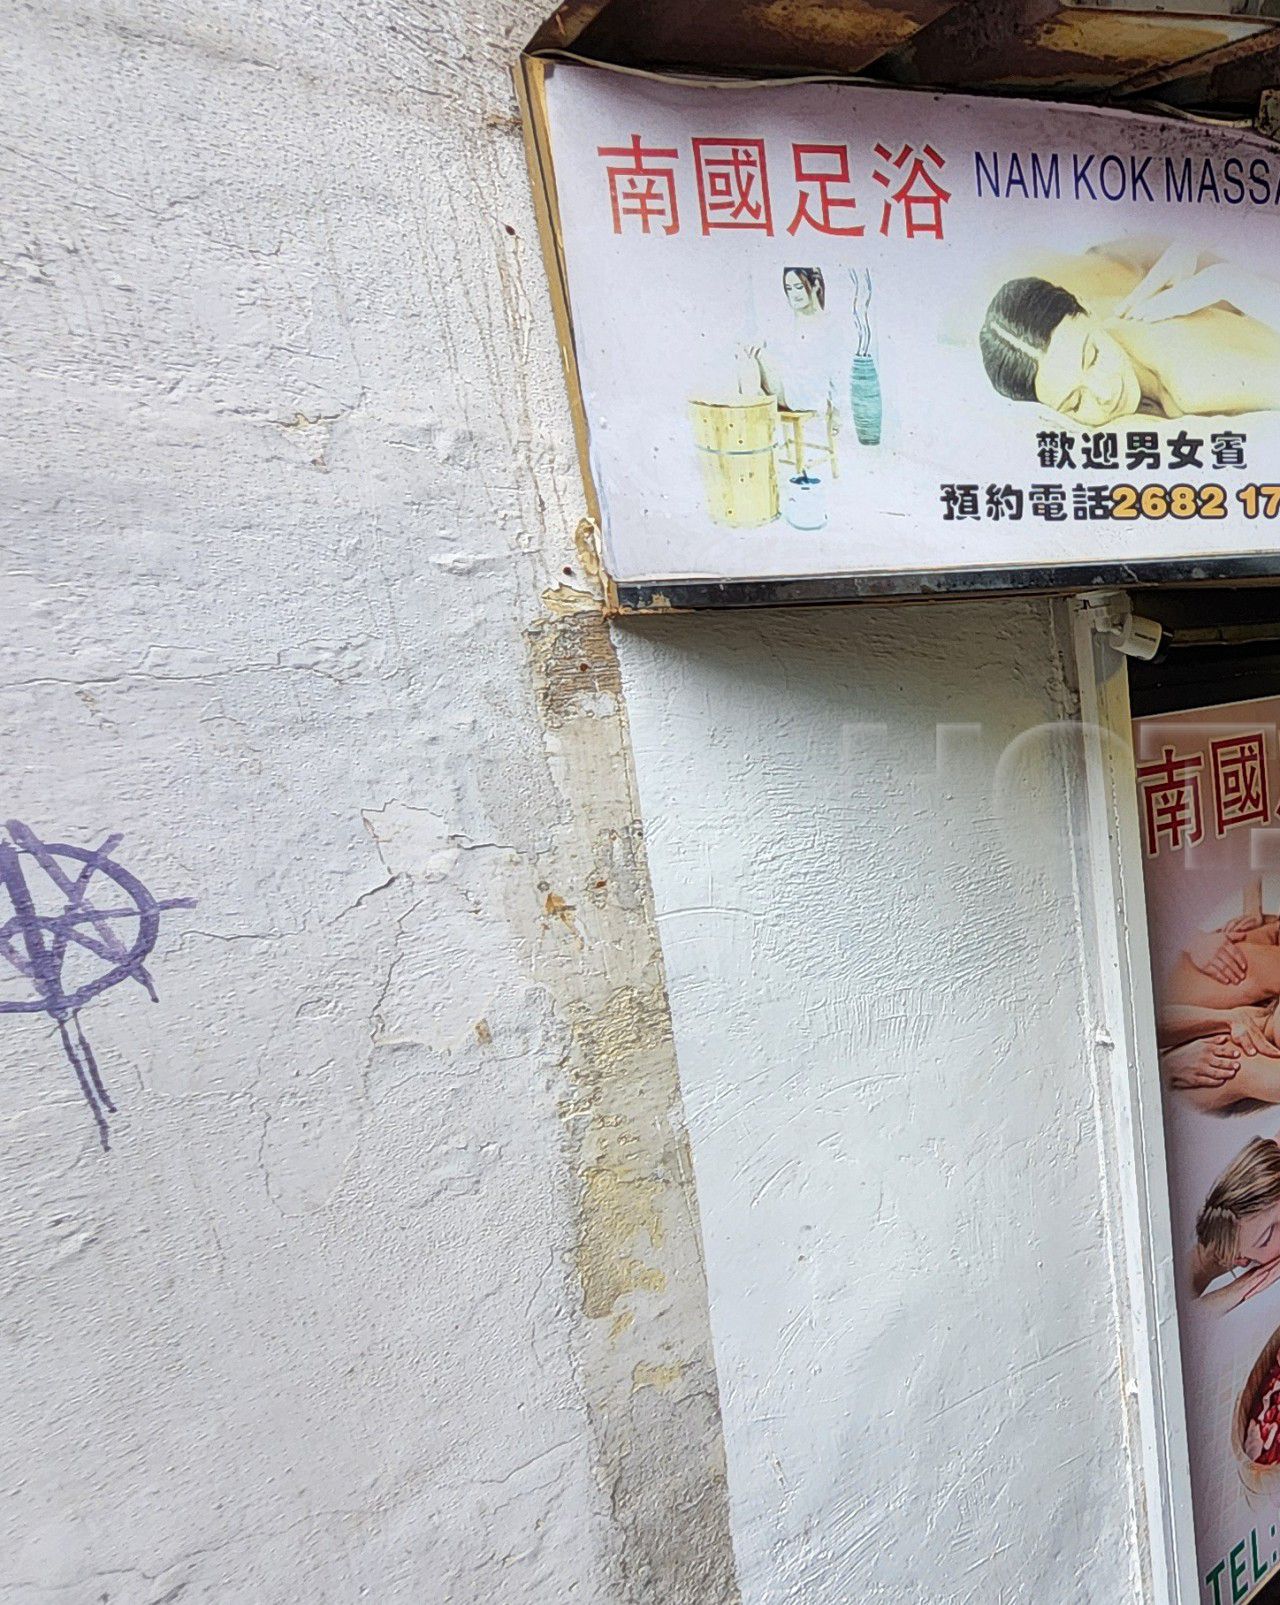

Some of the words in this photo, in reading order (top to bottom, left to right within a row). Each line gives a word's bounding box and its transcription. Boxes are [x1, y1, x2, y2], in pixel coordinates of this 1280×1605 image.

[597, 133, 952, 240] 南國足浴
[974, 151, 1062, 200] NAM
[1072, 153, 1155, 202] KOK
[1035, 430, 1249, 471] 歡迎男女賓
